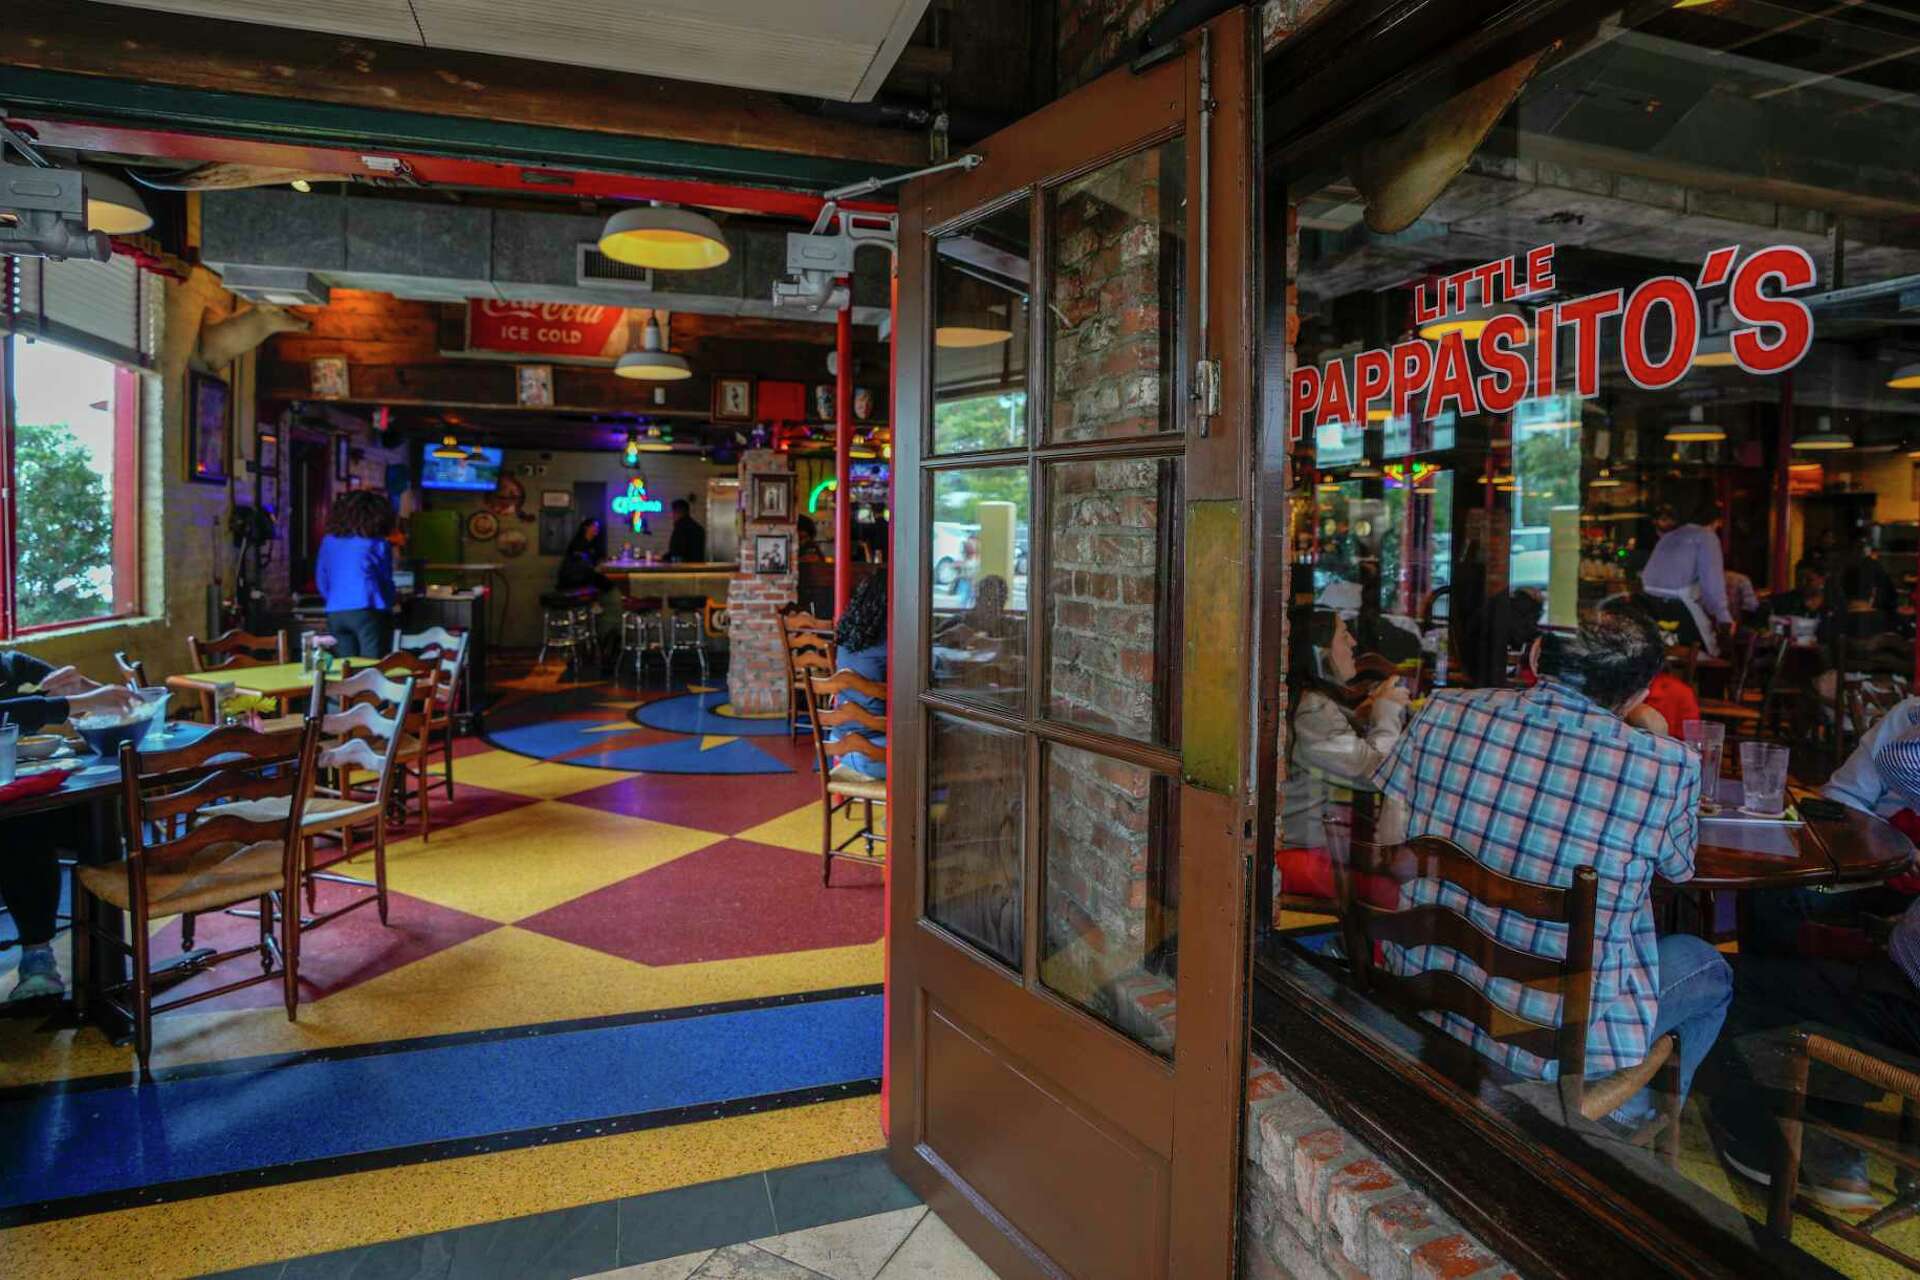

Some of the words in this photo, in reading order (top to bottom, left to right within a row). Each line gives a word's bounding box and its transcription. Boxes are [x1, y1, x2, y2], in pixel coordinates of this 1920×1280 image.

[1415, 243, 1556, 324] LITTLE
[501, 325, 529, 340] ICE
[537, 327, 582, 344] COLD
[1289, 245, 1816, 441] PAPPASITO'S
